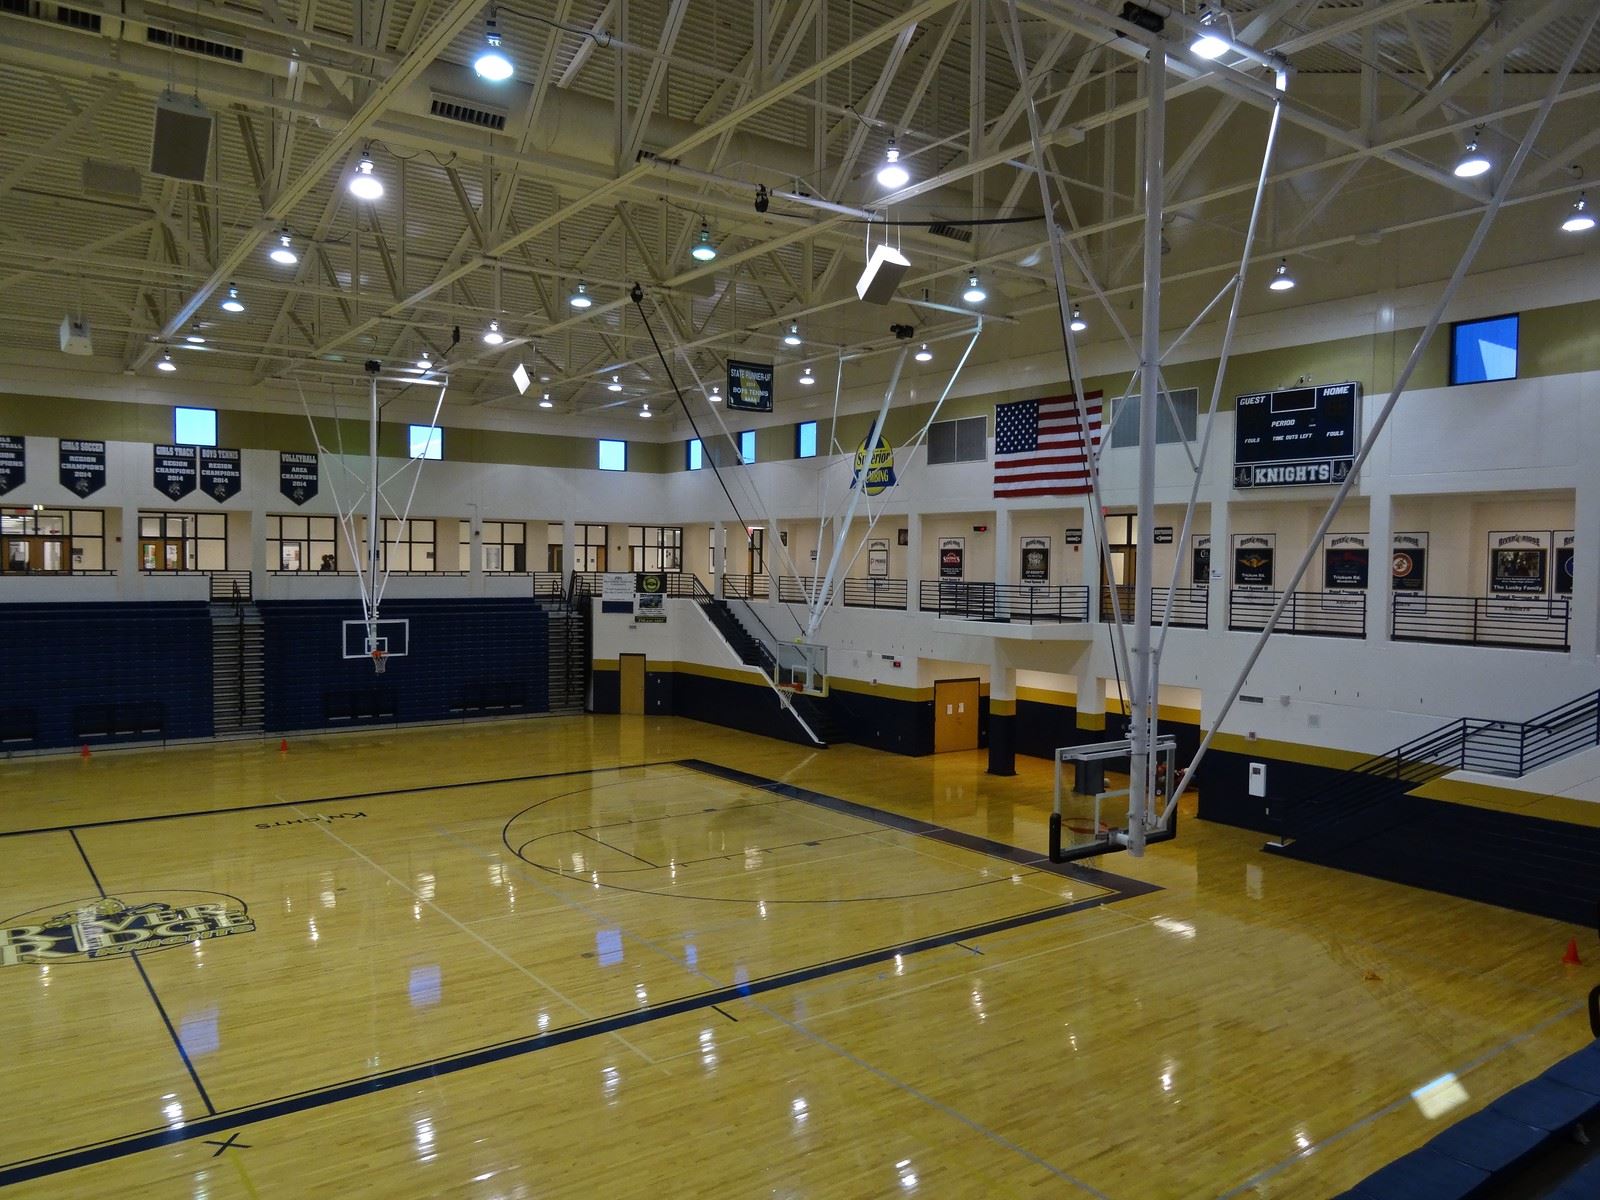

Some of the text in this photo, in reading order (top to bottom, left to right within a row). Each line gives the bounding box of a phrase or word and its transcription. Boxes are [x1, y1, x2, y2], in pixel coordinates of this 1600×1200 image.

[1323, 386, 1350, 396] HOME
[1240, 396, 1266, 406] GUEST
[1272, 419, 1295, 428] PERIOD
[61, 441, 104, 452] GIRLS SOCCER
[156, 446, 194, 457] GIRLS TRACK
[202, 449, 238, 459] BOYS TENNIS
[282, 454, 317, 464] VOLLEYBALL
[155, 467, 195, 475] CHAMPIONS
[1255, 464, 1329, 483] KNIGHTS
[256, 812, 368, 829] KNIGHTS
[92, 923, 256, 957] KNIGHTS
